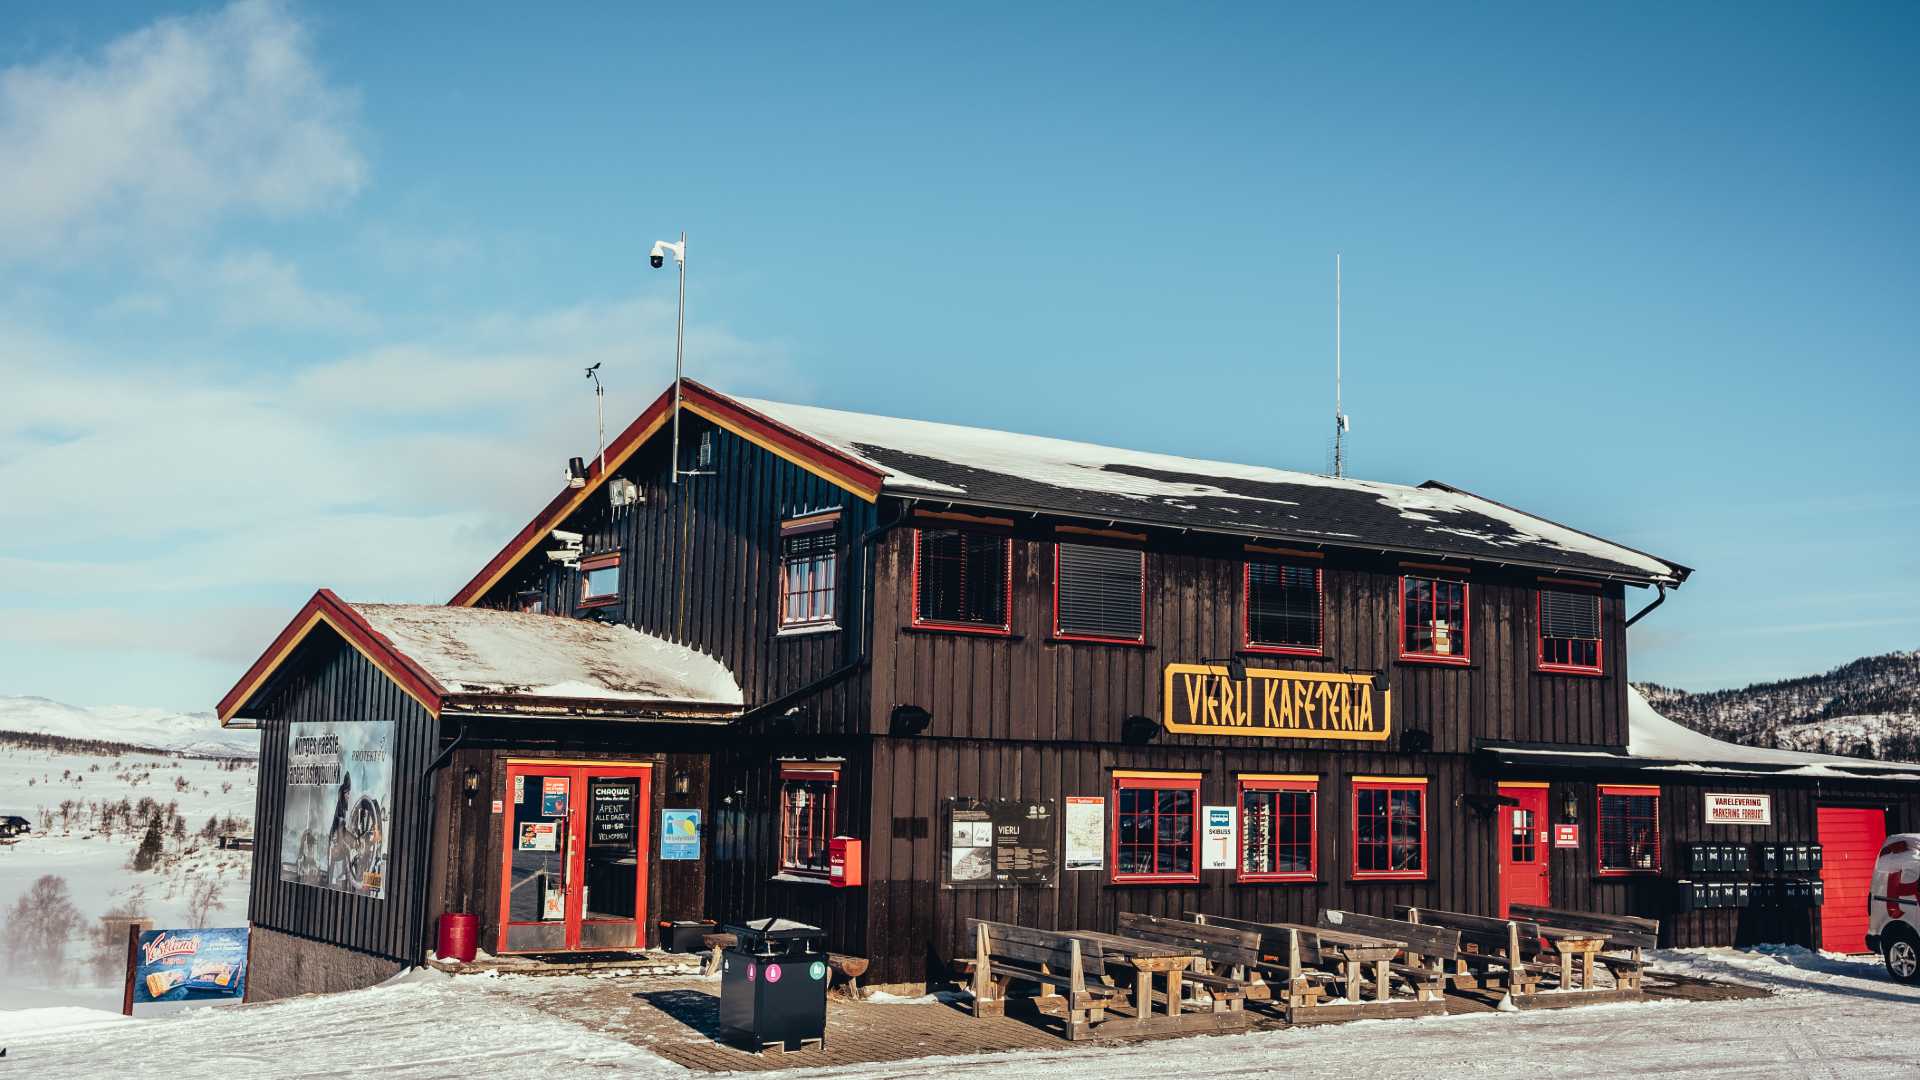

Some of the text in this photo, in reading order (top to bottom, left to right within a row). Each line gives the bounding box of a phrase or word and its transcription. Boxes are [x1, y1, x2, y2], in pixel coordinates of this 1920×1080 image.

[1264, 678, 1374, 731] KAFETERIA
[596, 788, 630, 797] CHAQWA
[1715, 797, 1761, 807] VARELEVERING
[998, 825, 1020, 835] VIERLI
